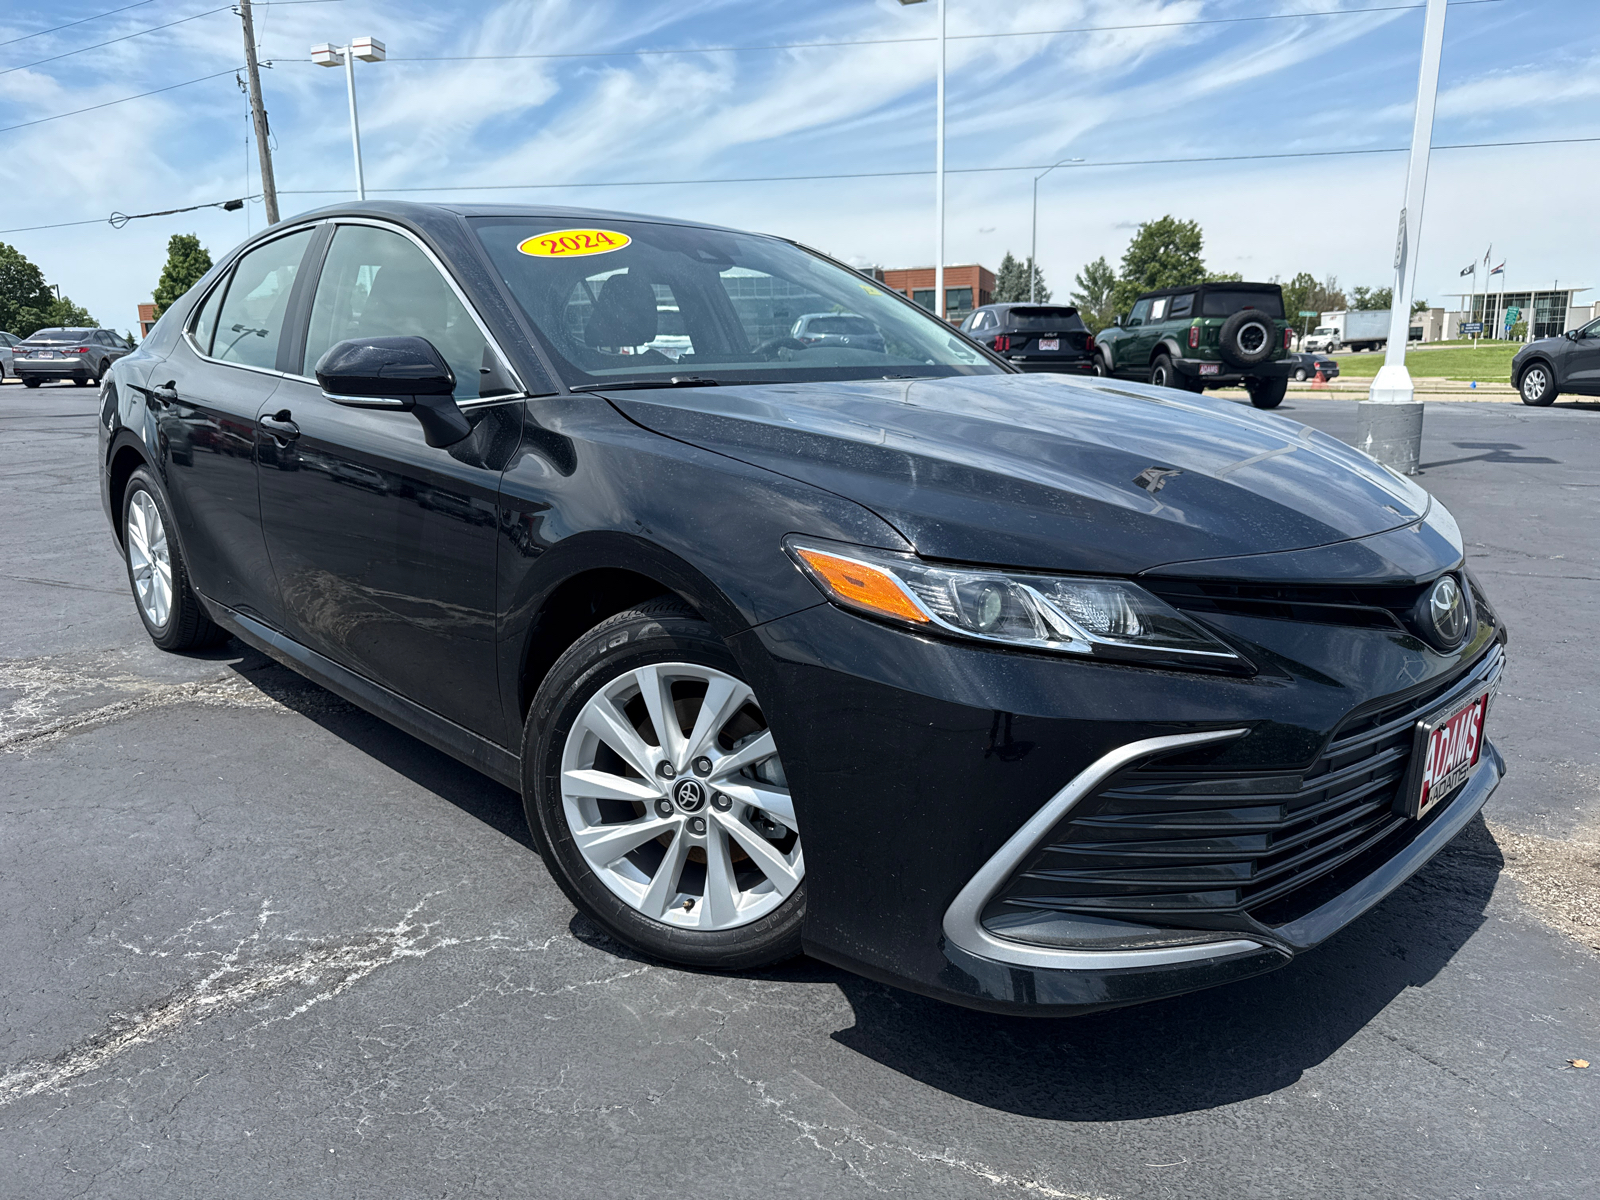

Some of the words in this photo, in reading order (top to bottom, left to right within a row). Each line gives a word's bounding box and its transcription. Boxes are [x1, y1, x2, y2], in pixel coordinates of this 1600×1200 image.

[540, 232, 616, 254] 2024
[1200, 365, 1218, 374] ADAMS
[1424, 704, 1481, 789] ADAMS
[1432, 762, 1468, 804] ADAMS
